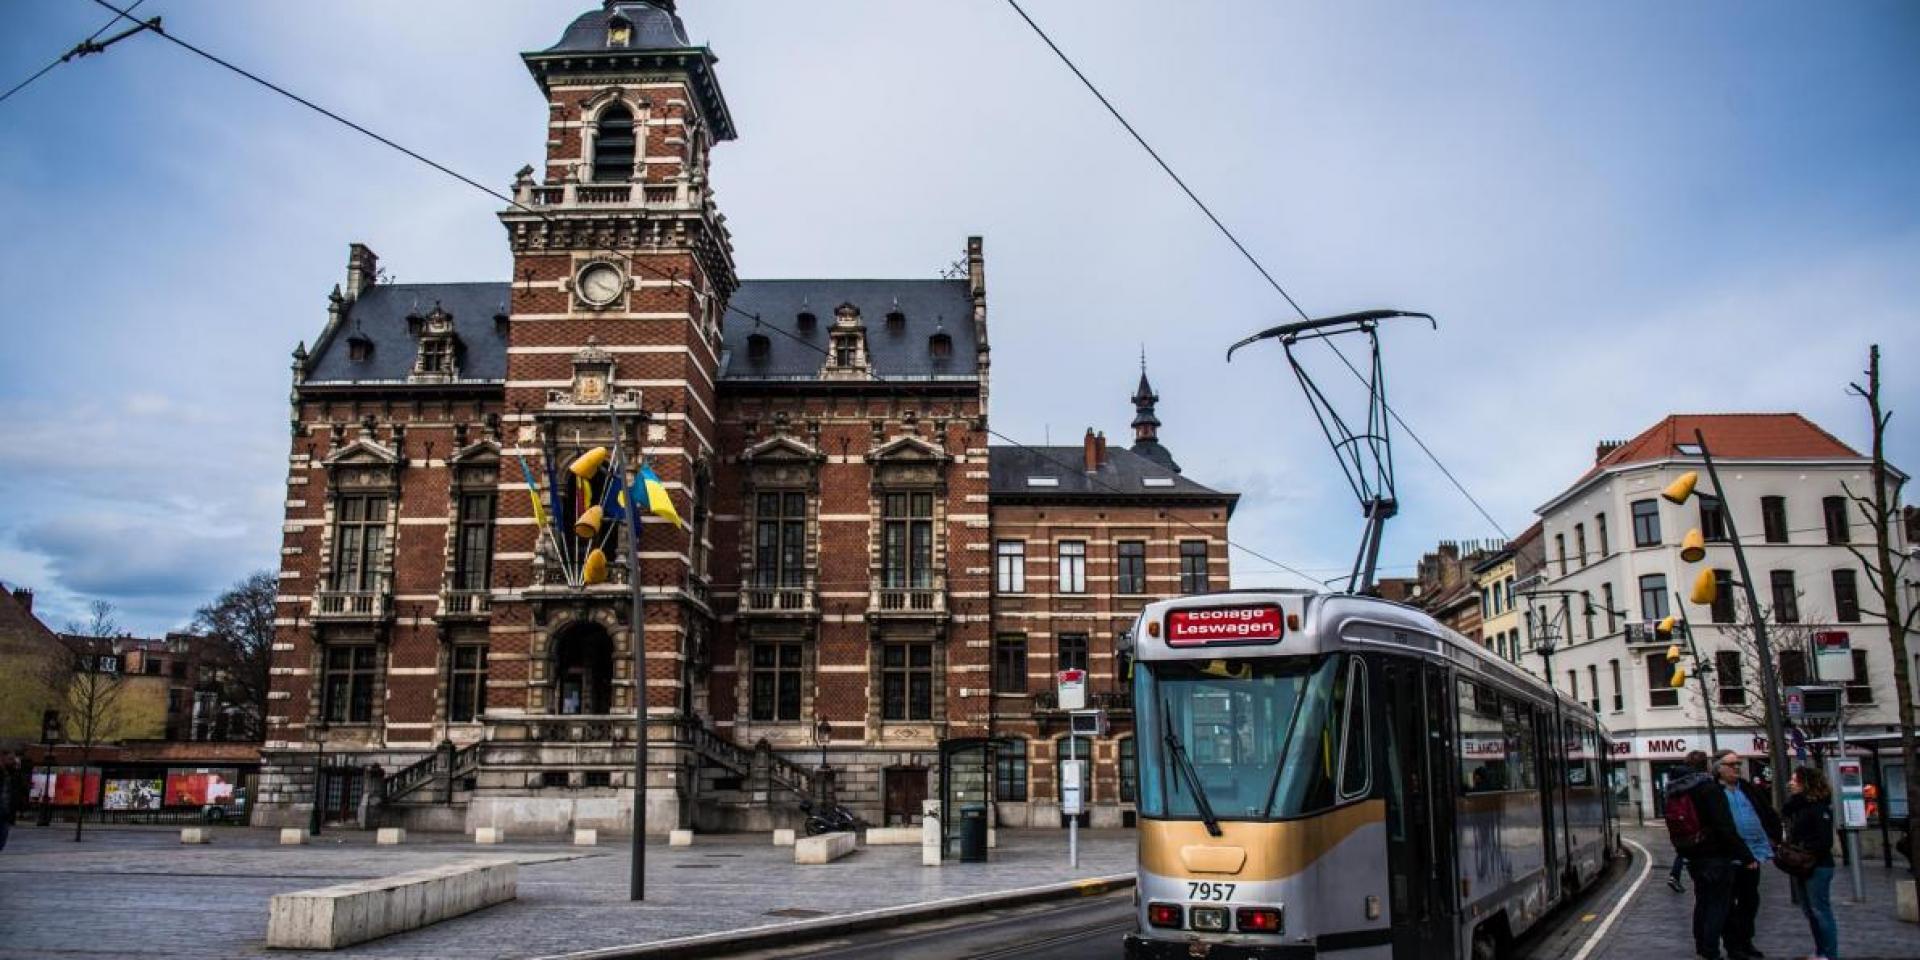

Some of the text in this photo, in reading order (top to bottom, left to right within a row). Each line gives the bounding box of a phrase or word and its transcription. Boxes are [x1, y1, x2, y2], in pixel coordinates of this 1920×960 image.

[1177, 622, 1274, 635] Leswagen
[1648, 739, 1686, 752] MMC
[1188, 882, 1236, 901] 7957
